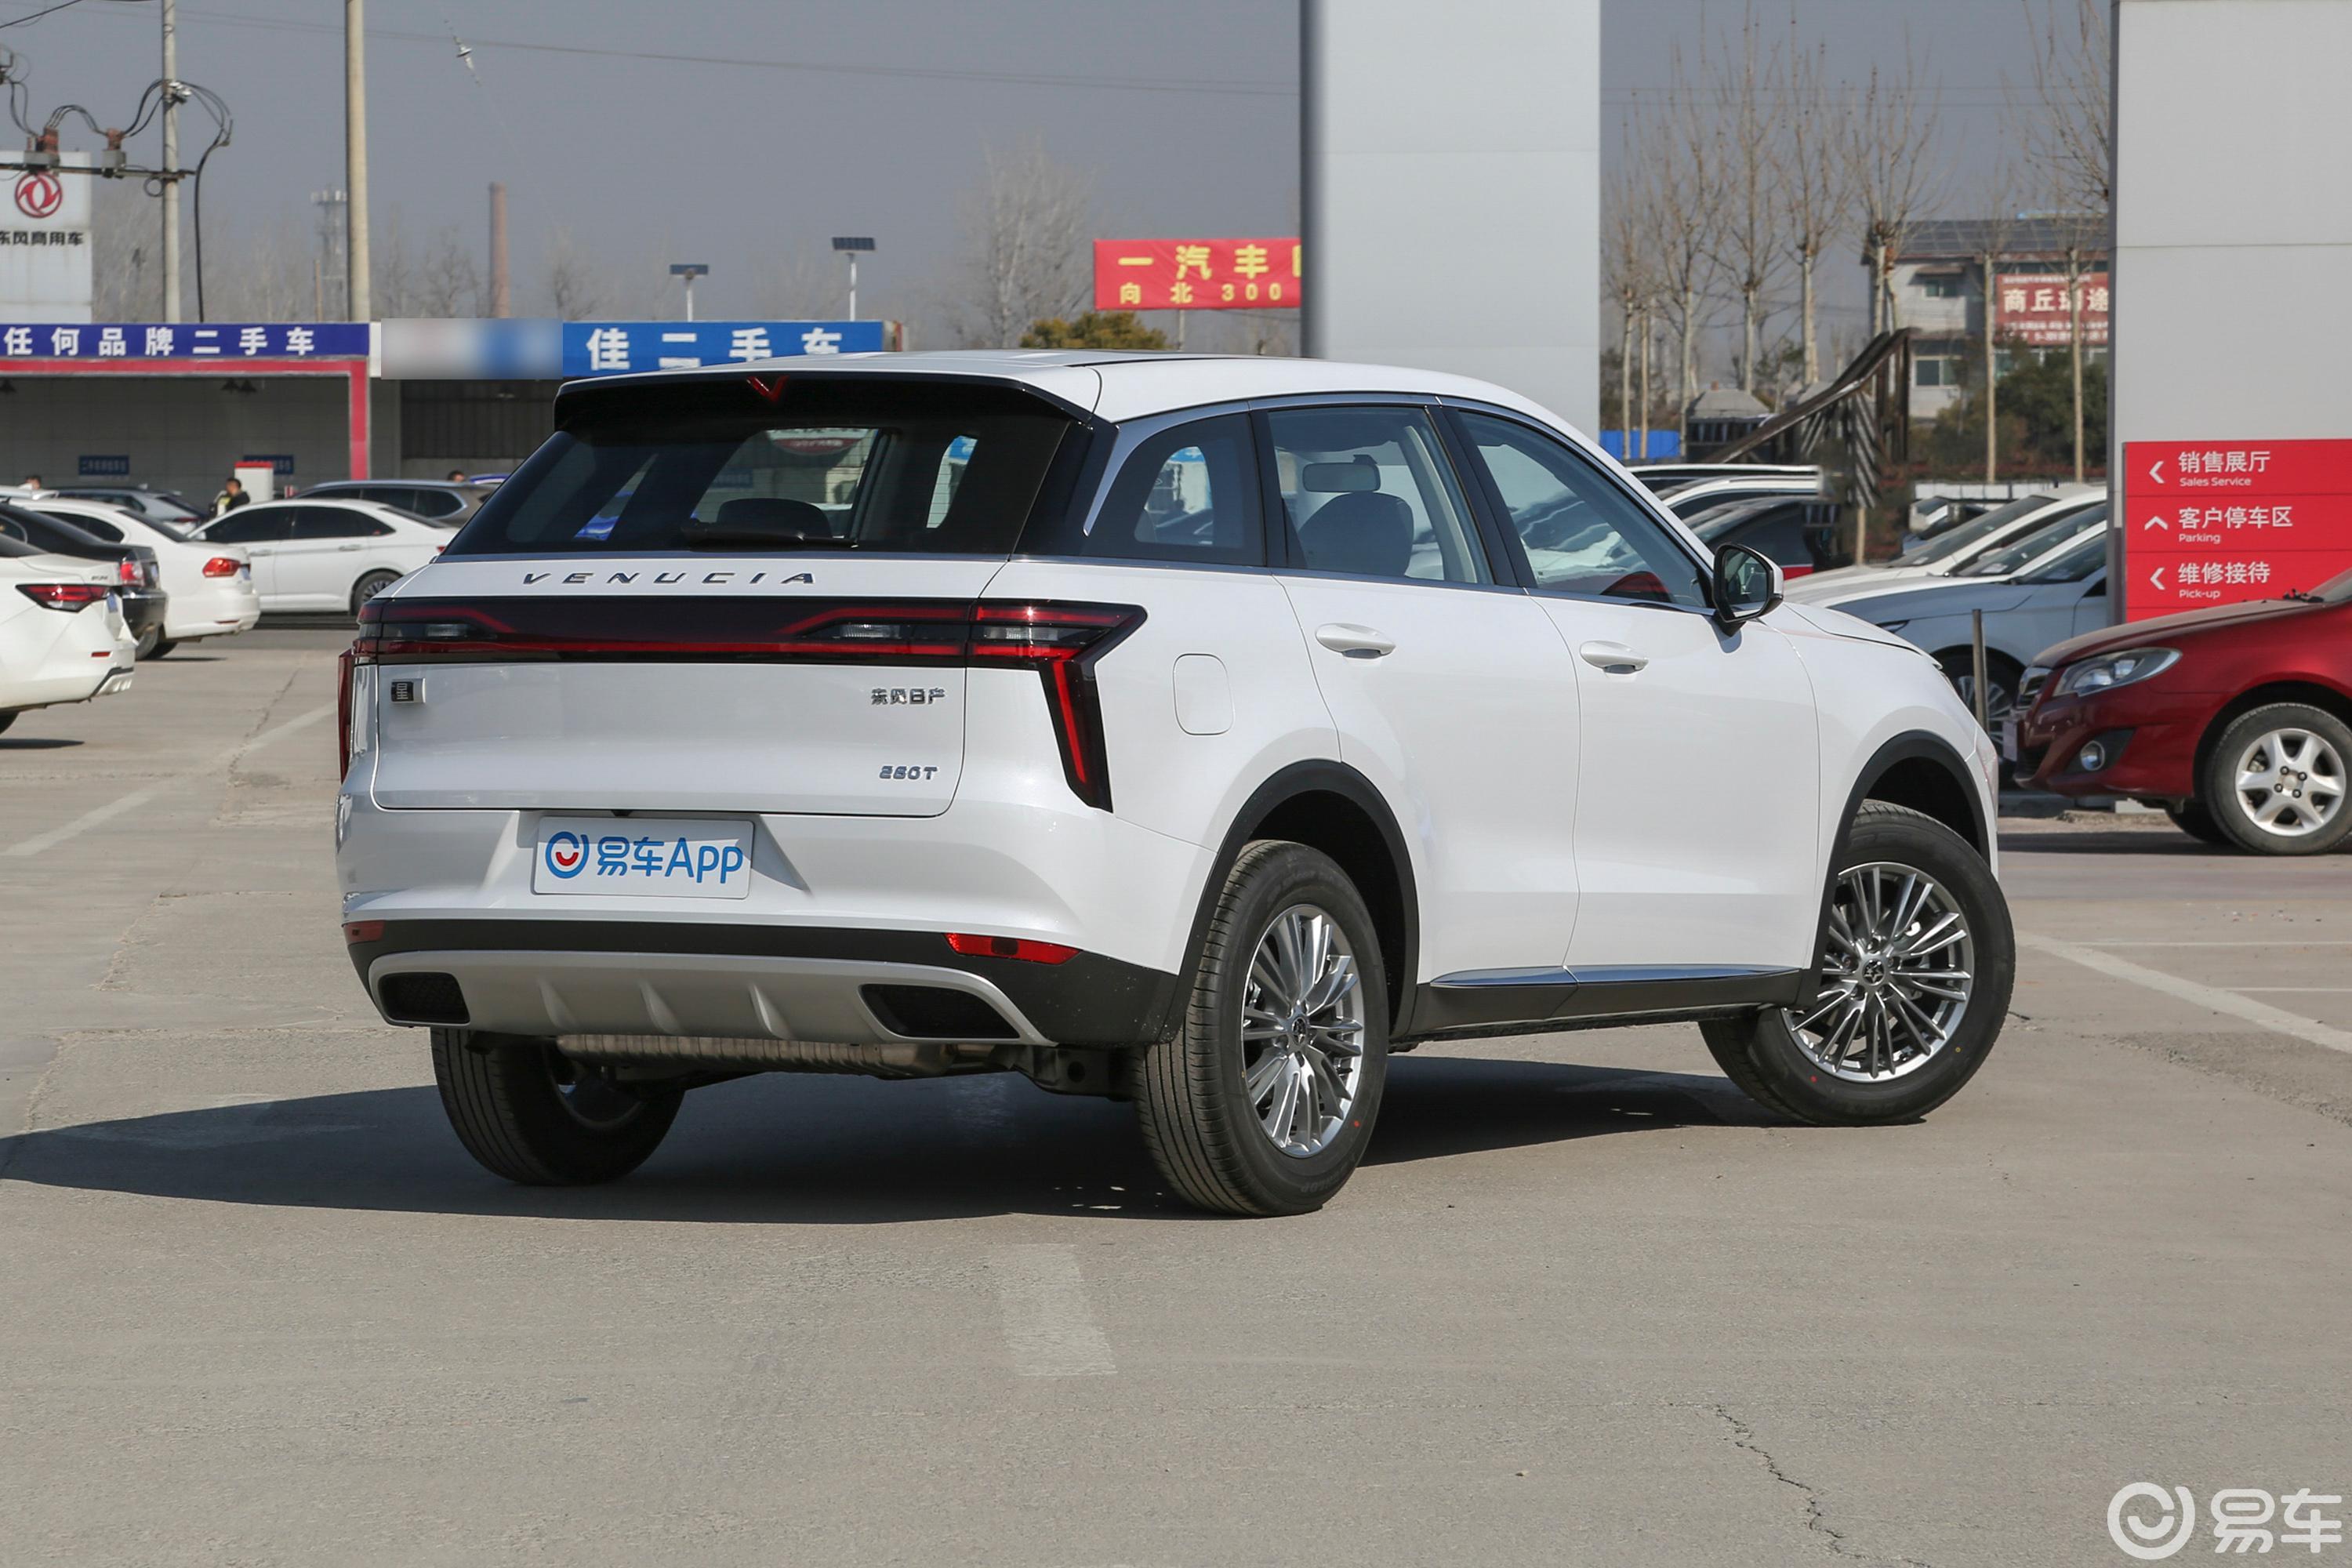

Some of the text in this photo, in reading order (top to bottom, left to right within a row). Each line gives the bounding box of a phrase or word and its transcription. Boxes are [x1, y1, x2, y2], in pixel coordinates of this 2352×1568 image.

[1117, 244, 1301, 281] 一汽丰
[3, 327, 314, 356] 任何品牌二手车
[2178, 451, 2270, 474] 销售展厅
[2180, 477, 2252, 487] Sales Service
[2178, 506, 2293, 529] 客户停车区
[2179, 533, 2221, 544] Parking
[522, 572, 815, 585] VENUCIA
[2178, 561, 2270, 585] 维修接待
[2179, 589, 2221, 599] Pick-up
[870, 688, 946, 705] 东风日产
[597, 837, 743, 884] 易车App
